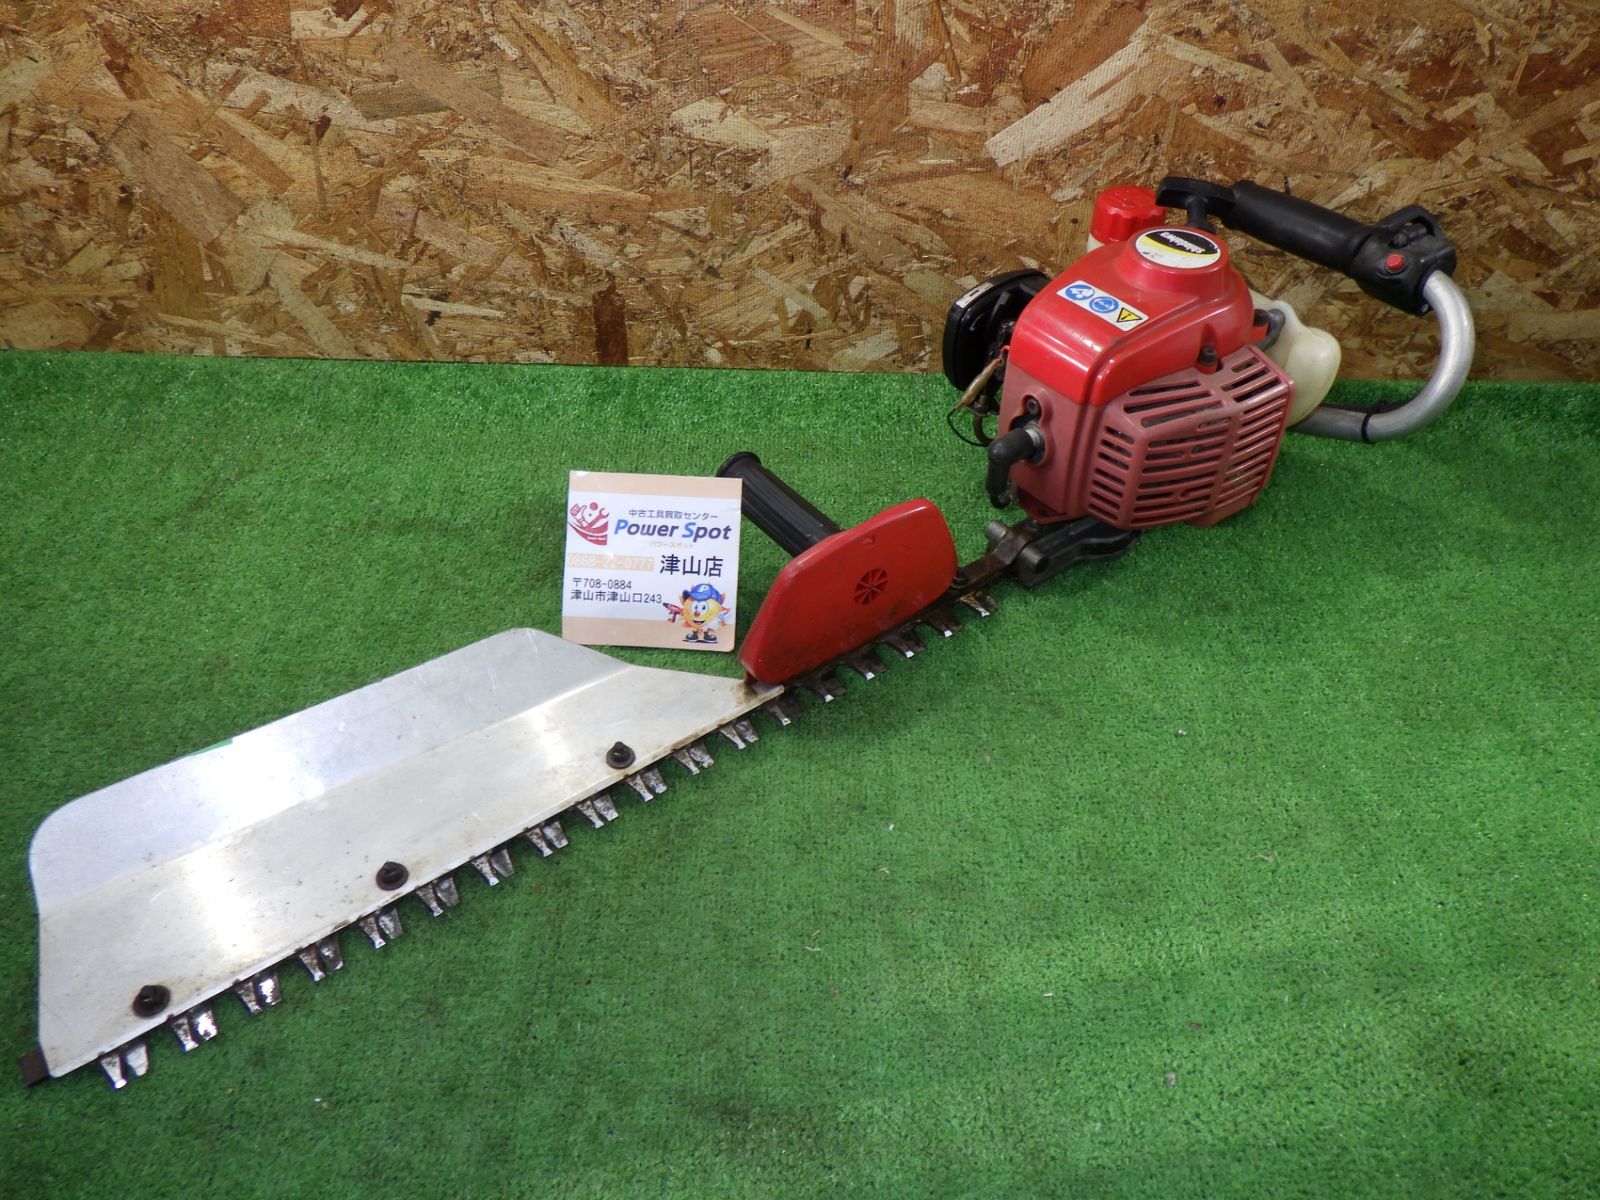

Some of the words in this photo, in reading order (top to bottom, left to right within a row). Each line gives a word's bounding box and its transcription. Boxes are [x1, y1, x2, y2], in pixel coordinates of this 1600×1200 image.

[628, 508, 719, 520] 中古工具買取センター
[614, 519, 679, 538] Power
[682, 522, 732, 542] Spot
[660, 554, 724, 577] 津山店
[570, 589, 663, 604] 津山市津山口243
